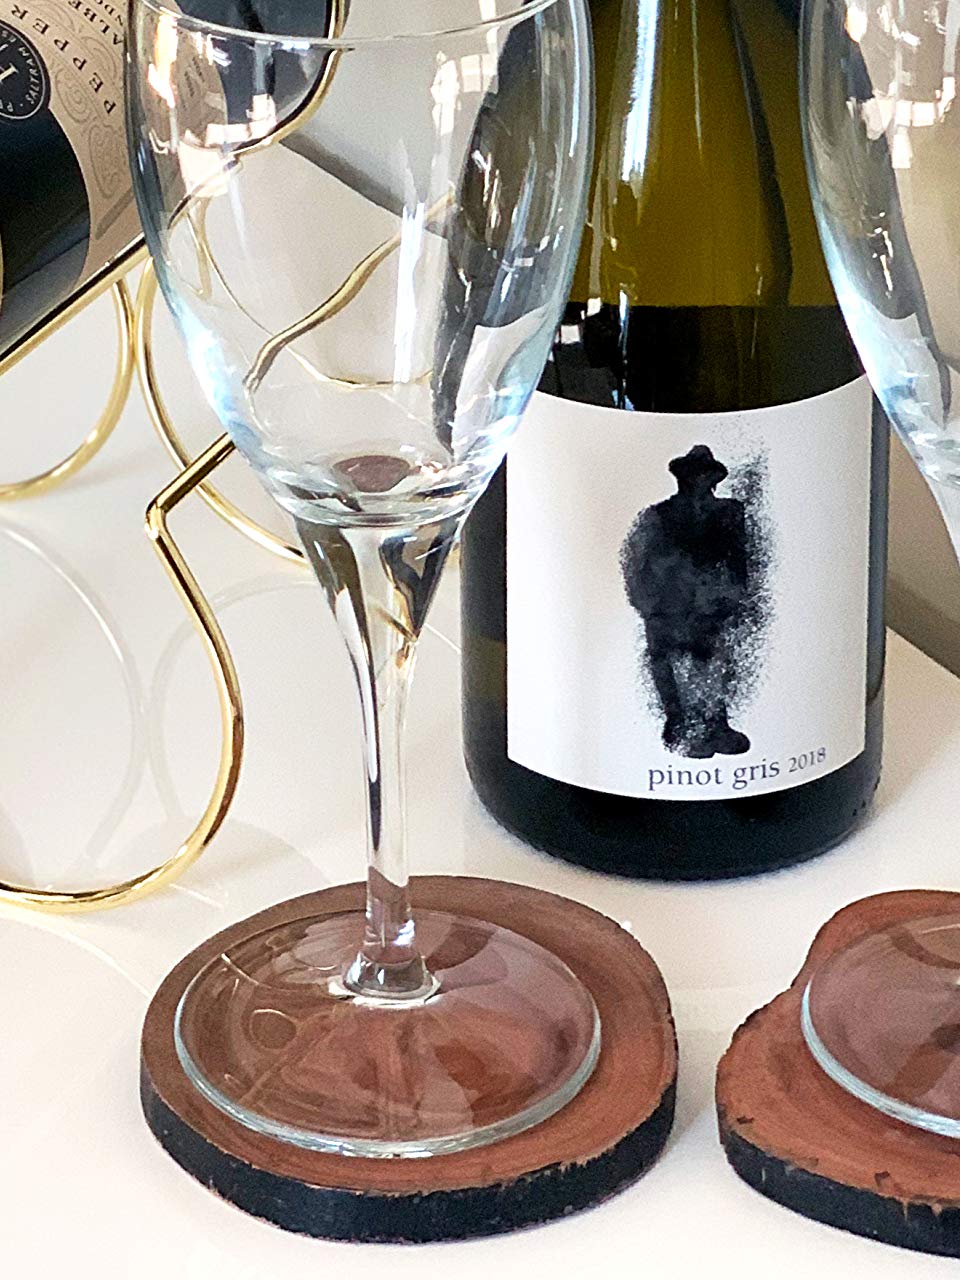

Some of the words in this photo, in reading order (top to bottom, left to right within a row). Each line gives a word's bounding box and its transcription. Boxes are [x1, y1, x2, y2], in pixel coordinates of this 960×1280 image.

[19, 46, 40, 104] SALTRAM
[648, 765, 724, 791] pinot
[732, 759, 780, 790] gris
[789, 746, 827, 773] 2018
